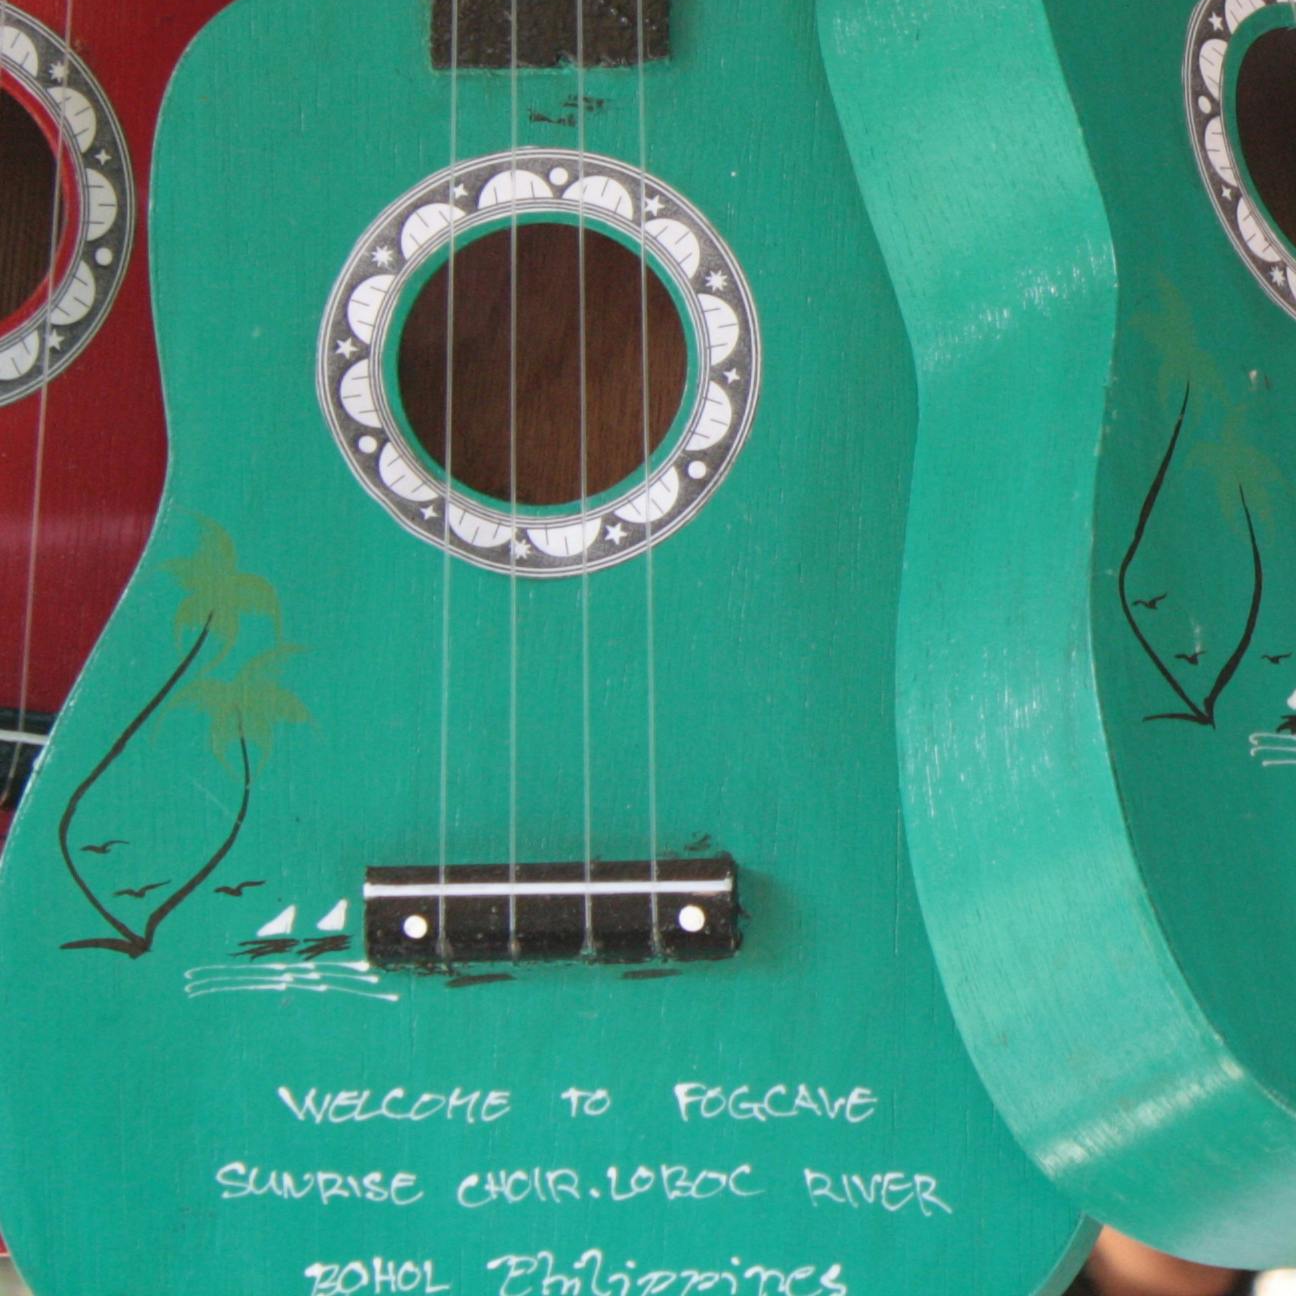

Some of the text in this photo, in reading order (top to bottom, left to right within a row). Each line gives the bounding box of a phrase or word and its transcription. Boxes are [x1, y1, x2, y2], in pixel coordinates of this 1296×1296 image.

[277, 1082, 879, 1124] WELCOME TO FOGCAVE
[215, 1161, 425, 1207] SUNRISE
[803, 1169, 953, 1217] RIVER
[305, 1257, 452, 1296] BOHOL
